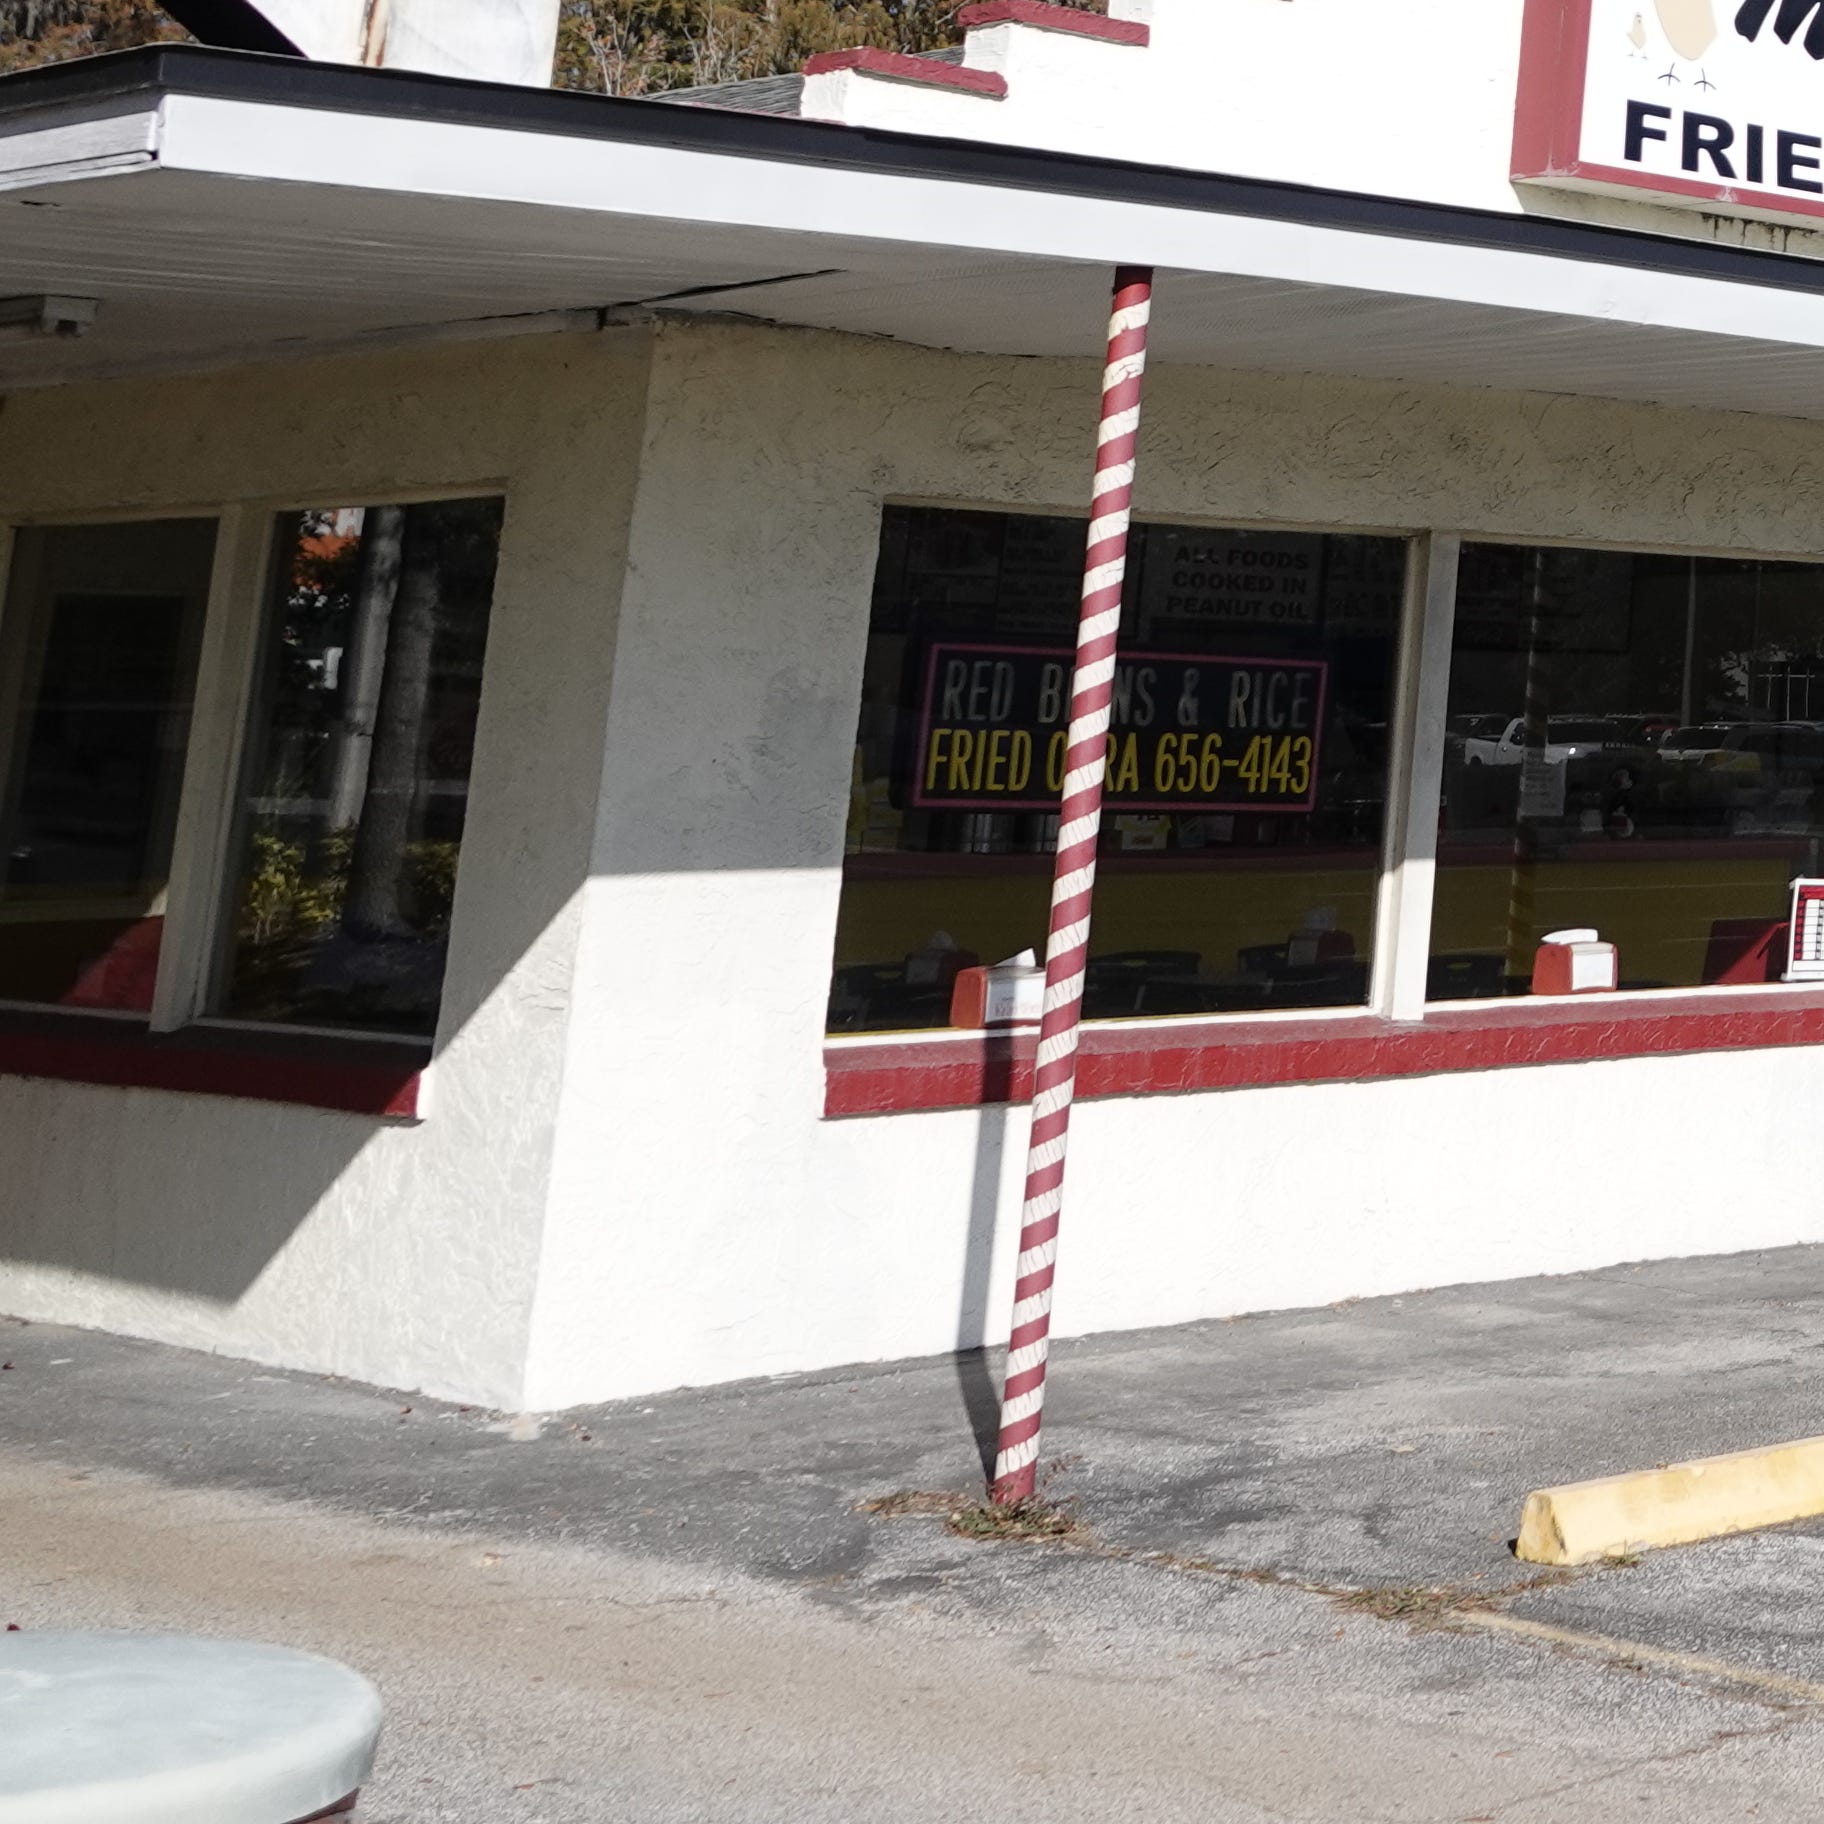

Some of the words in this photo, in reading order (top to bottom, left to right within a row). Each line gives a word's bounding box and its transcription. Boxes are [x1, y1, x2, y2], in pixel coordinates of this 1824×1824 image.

[1174, 545, 1217, 564] ALL
[1226, 548, 1309, 571] FOODS
[1171, 571, 1274, 594] COOKED
[1281, 576, 1307, 595] IN
[1165, 594, 1263, 618] PEANUT
[1269, 598, 1308, 620] OIL
[941, 659, 1014, 723] RED
[1037, 662, 1157, 729] BNS
[1176, 667, 1200, 727] &
[1228, 670, 1311, 730] RICE
[925, 727, 1033, 793] FRIED
[1045, 730, 1140, 793] ORA
[1153, 731, 1313, 794] 656-4143
